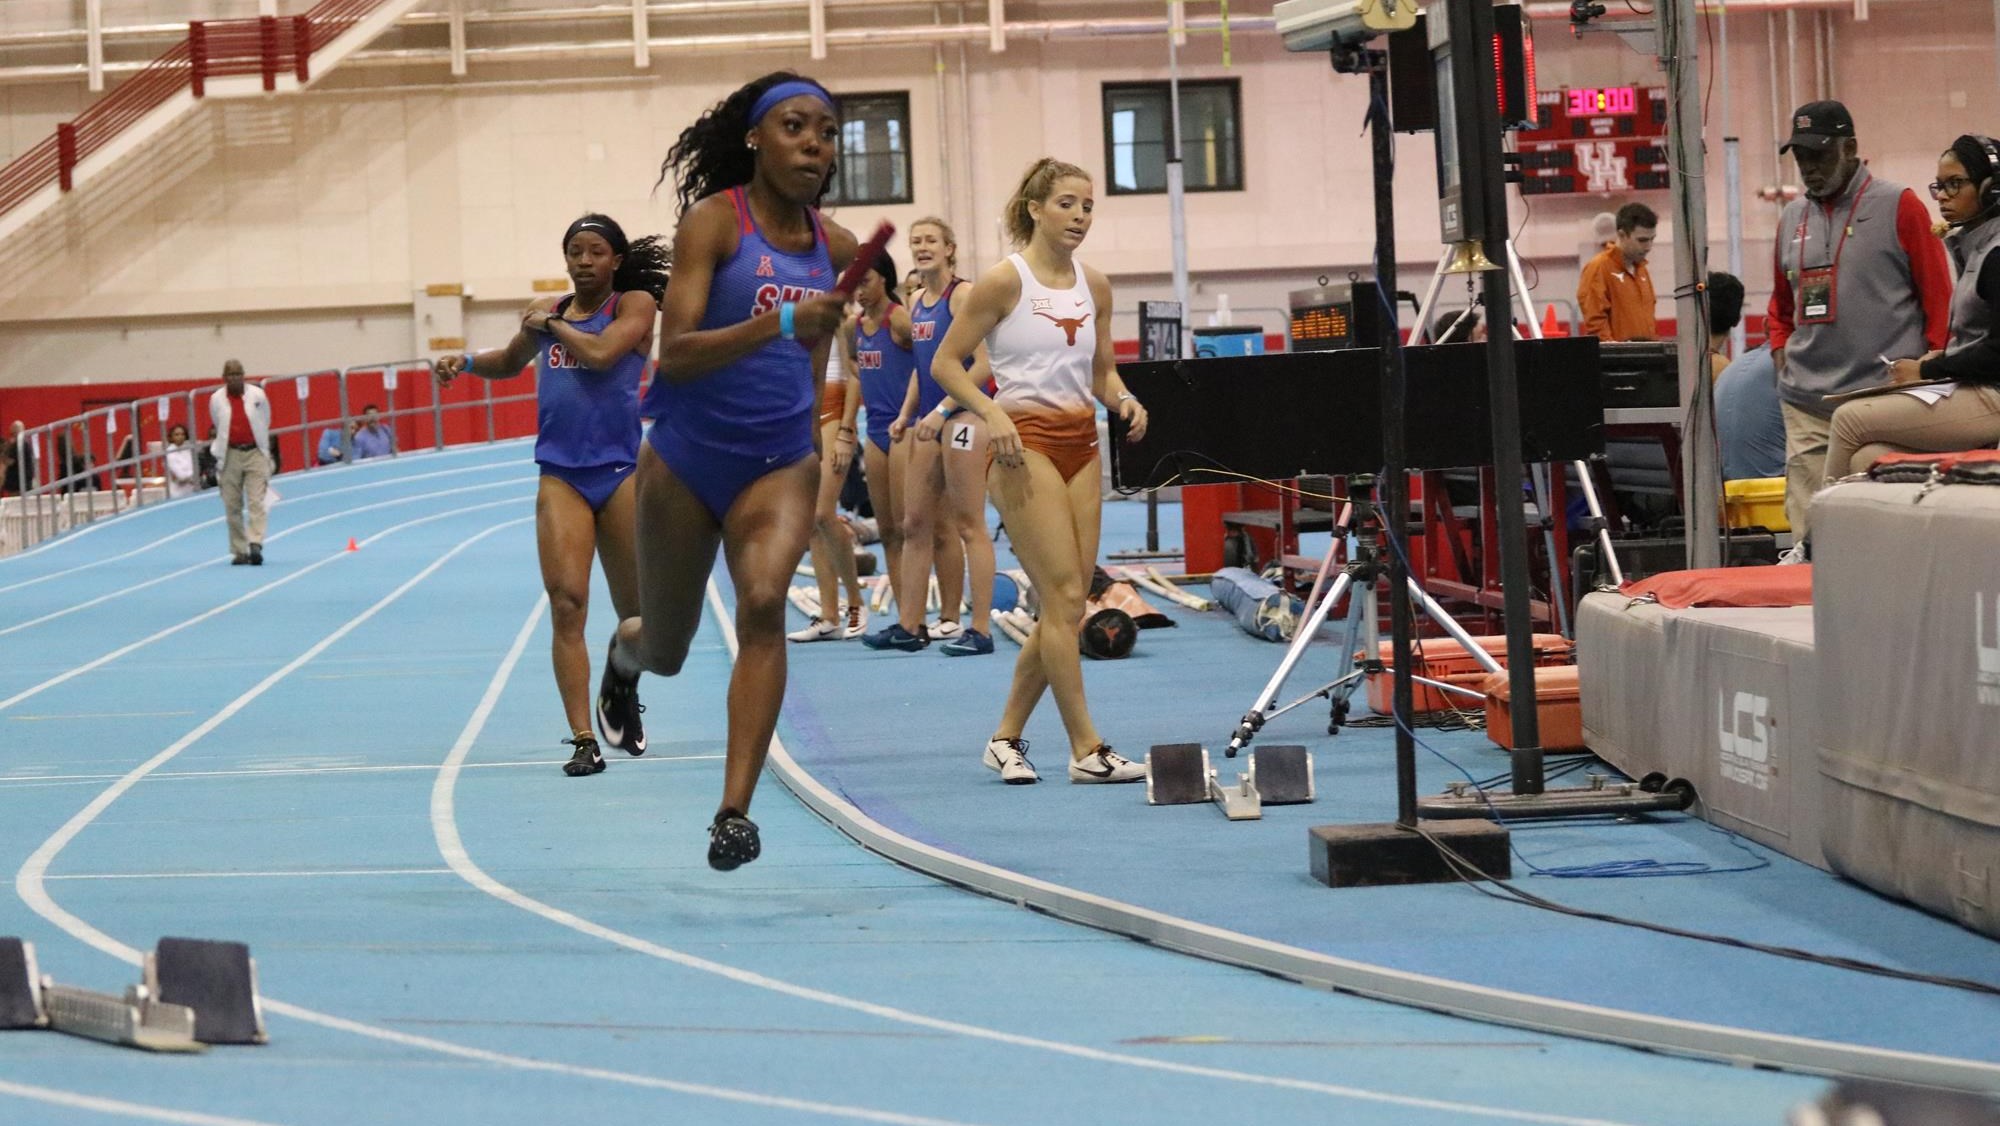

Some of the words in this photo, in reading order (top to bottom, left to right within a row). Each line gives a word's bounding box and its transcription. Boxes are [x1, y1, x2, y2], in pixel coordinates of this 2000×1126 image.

[1568, 87, 1634, 116] 30:00
[751, 283, 825, 318] SM
[549, 343, 589, 368] SM
[954, 426, 969, 448] 4
